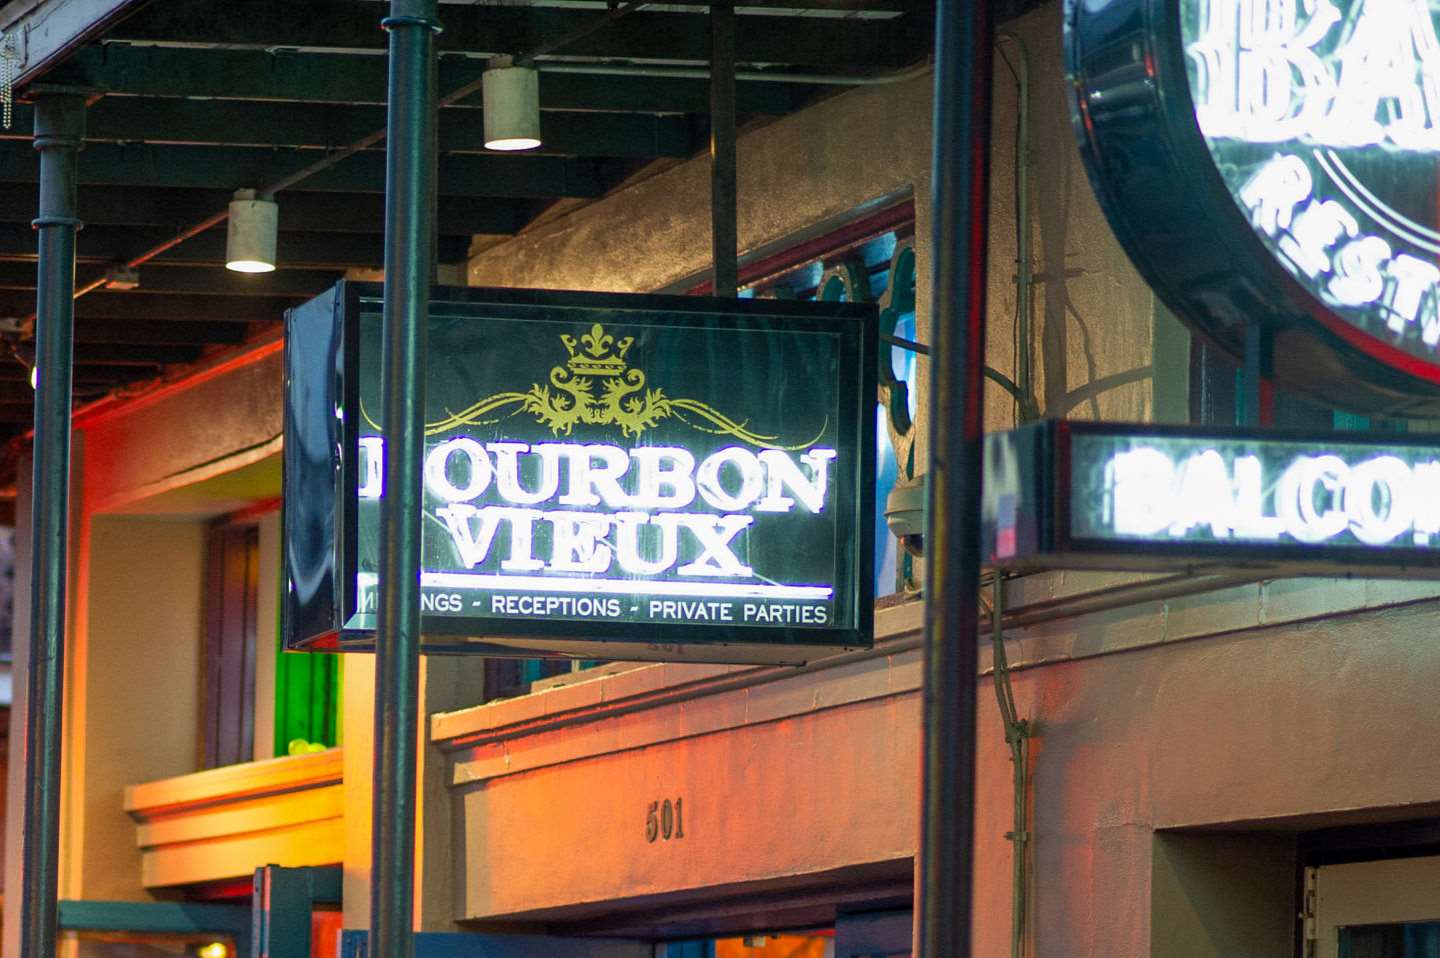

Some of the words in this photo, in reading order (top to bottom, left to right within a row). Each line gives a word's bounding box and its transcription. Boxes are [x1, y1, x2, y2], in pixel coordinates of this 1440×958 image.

[1238, 152, 1440, 345] REST
[436, 502, 754, 577] VIEUX
[491, 595, 620, 617] RECEPTIONS
[649, 600, 733, 621] PRIVATE
[743, 603, 828, 624] PARTIES
